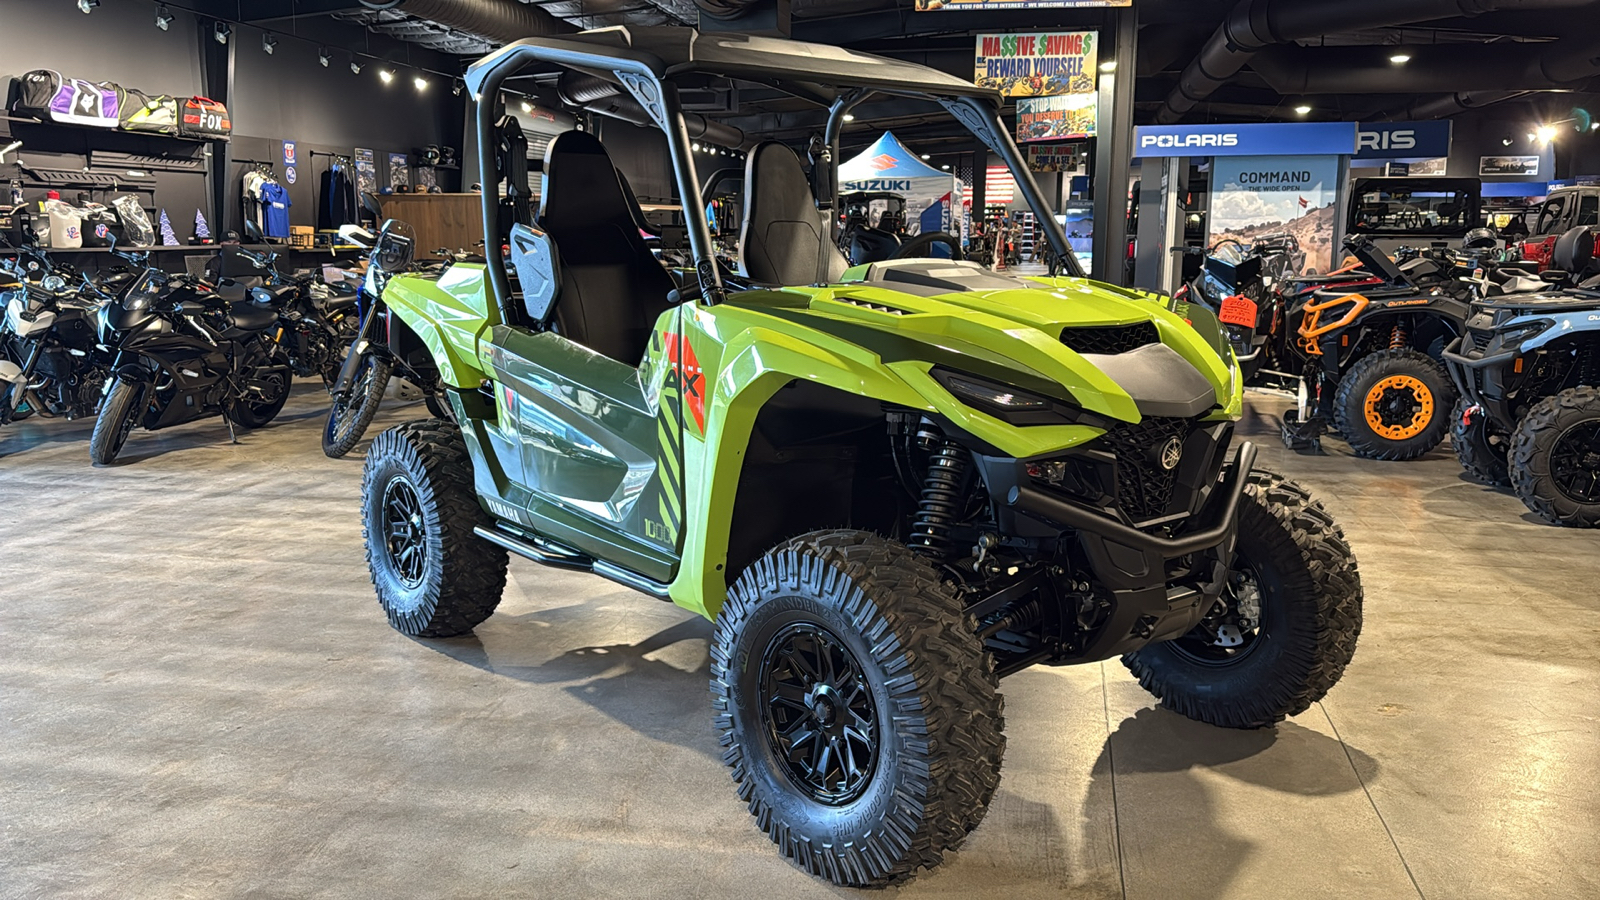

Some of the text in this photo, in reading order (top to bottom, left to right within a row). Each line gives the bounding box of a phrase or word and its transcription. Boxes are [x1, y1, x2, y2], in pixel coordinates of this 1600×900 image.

[987, 57, 1084, 78] REWARD YOURSELF
[27, 73, 45, 82] FOX
[1030, 98, 1049, 113] STOP
[199, 113, 222, 130] FOX
[1021, 114, 1034, 124] YOU
[1036, 111, 1063, 122] DESERVE
[1141, 133, 1238, 148] POLARIS
[1061, 156, 1070, 165] SEE
[1239, 170, 1311, 184] COMMAND
[844, 180, 911, 191] SUZUKI
[940, 199, 950, 233] SUZU
[1387, 299, 1428, 307] OUTLANDER
[485, 497, 523, 525] YAMAHA
[644, 518, 671, 544] 1000
